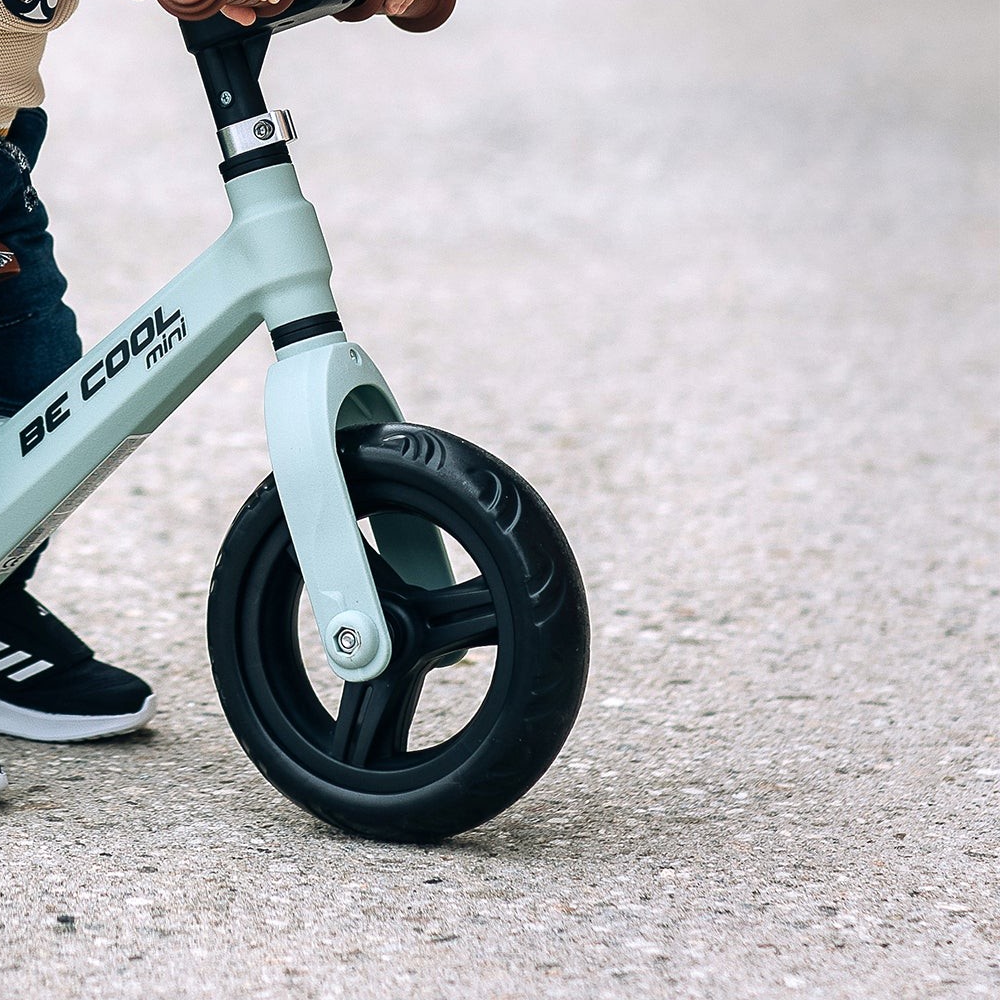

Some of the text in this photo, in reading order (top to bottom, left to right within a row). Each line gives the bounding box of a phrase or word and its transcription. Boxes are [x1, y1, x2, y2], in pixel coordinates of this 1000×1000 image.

[18, 306, 181, 458] BE COOL
[145, 317, 188, 370] mini
